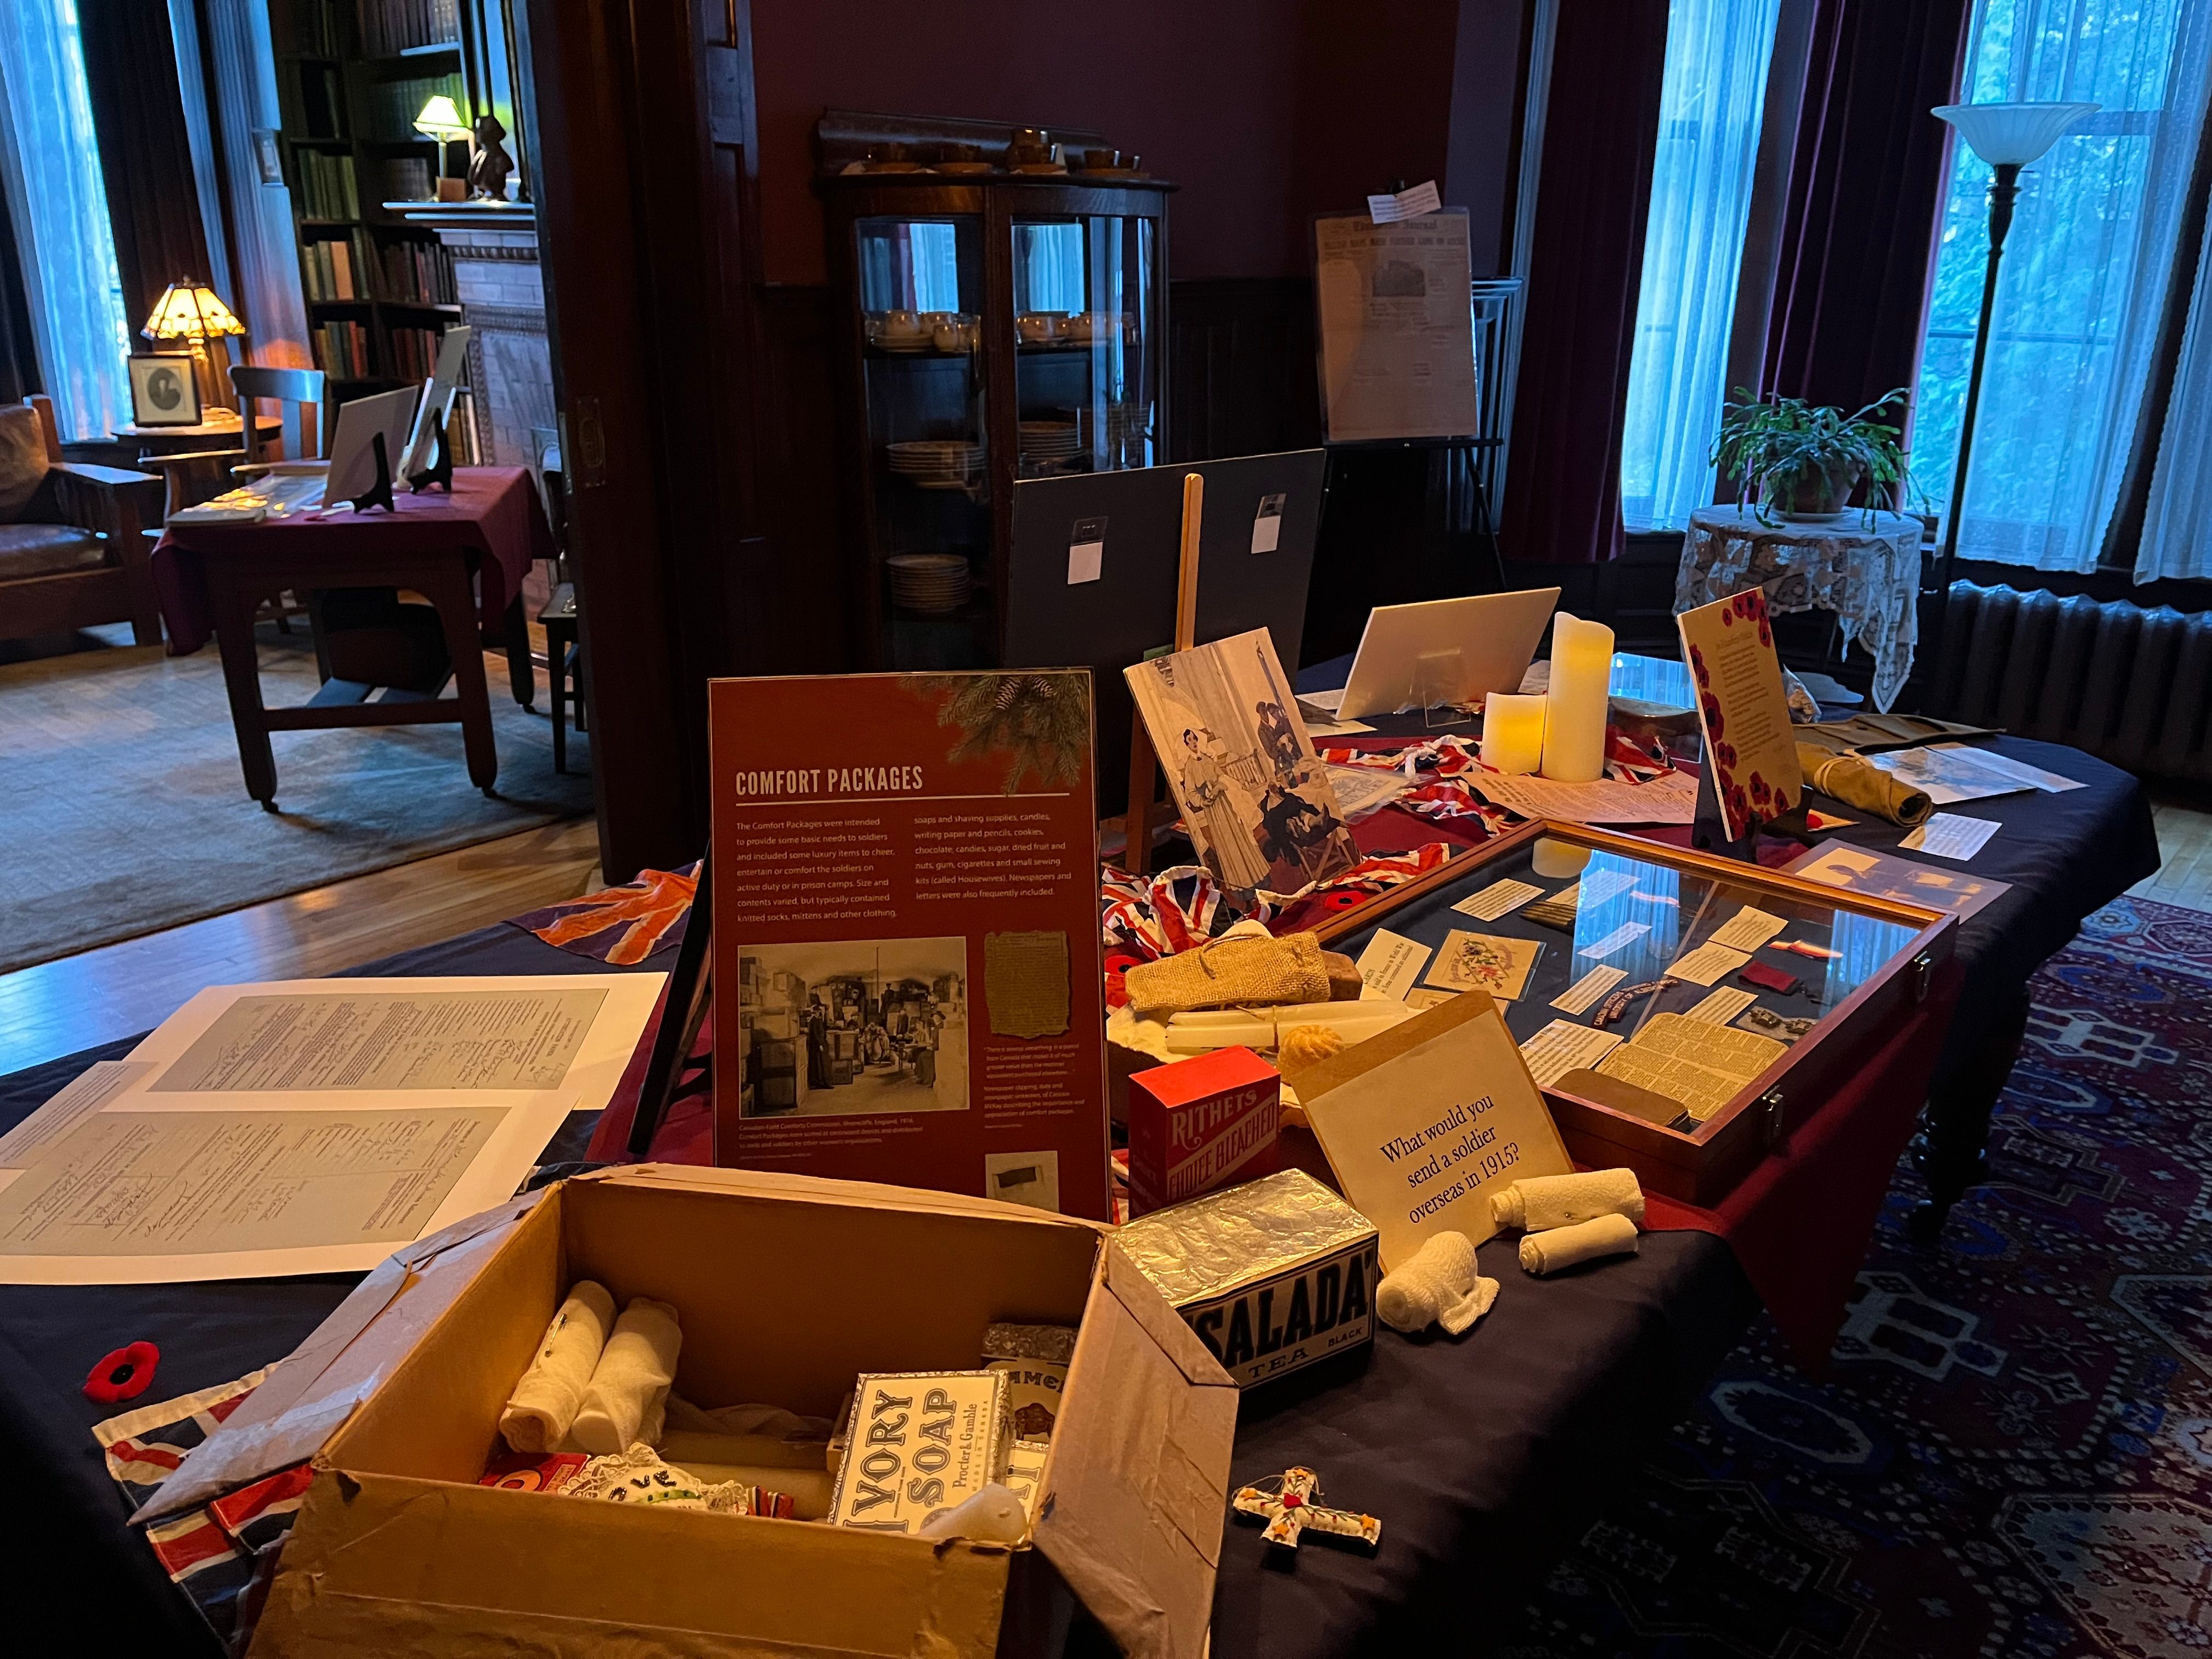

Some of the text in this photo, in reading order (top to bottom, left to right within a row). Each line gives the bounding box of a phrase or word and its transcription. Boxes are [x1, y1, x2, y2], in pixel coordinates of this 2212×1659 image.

[736, 766, 922, 795] COMFORT PACKAGES
[786, 821, 822, 829] Packages
[955, 814, 984, 823] shaving
[747, 838, 776, 847] provide
[915, 831, 942, 839] writing
[753, 851, 787, 860] included
[784, 866, 815, 874] comfort
[957, 861, 994, 869] cigarettes
[1034, 859, 1060, 867] sewing
[762, 883, 780, 891] duty
[801, 882, 825, 890] prison
[931, 876, 956, 884] (called
[817, 895, 848, 905] typically
[850, 893, 889, 902] contained
[979, 888, 1018, 898] frequently
[1171, 1090, 1257, 1150] RITHETS
[1379, 1095, 1494, 1163] What would you
[1169, 1149, 1212, 1200] CHOICE
[1216, 1102, 1274, 1172] BLEACHED
[1407, 1127, 1497, 1188] send a soldier
[1409, 1142, 1519, 1223] overseas in 1915?
[1328, 1327, 1362, 1347] BLACK
[1248, 1347, 1308, 1378] TEA
[907, 1388, 957, 1508] SOAP
[952, 1403, 978, 1488] Procter & Gamble
[843, 1390, 913, 1534] IVORY
